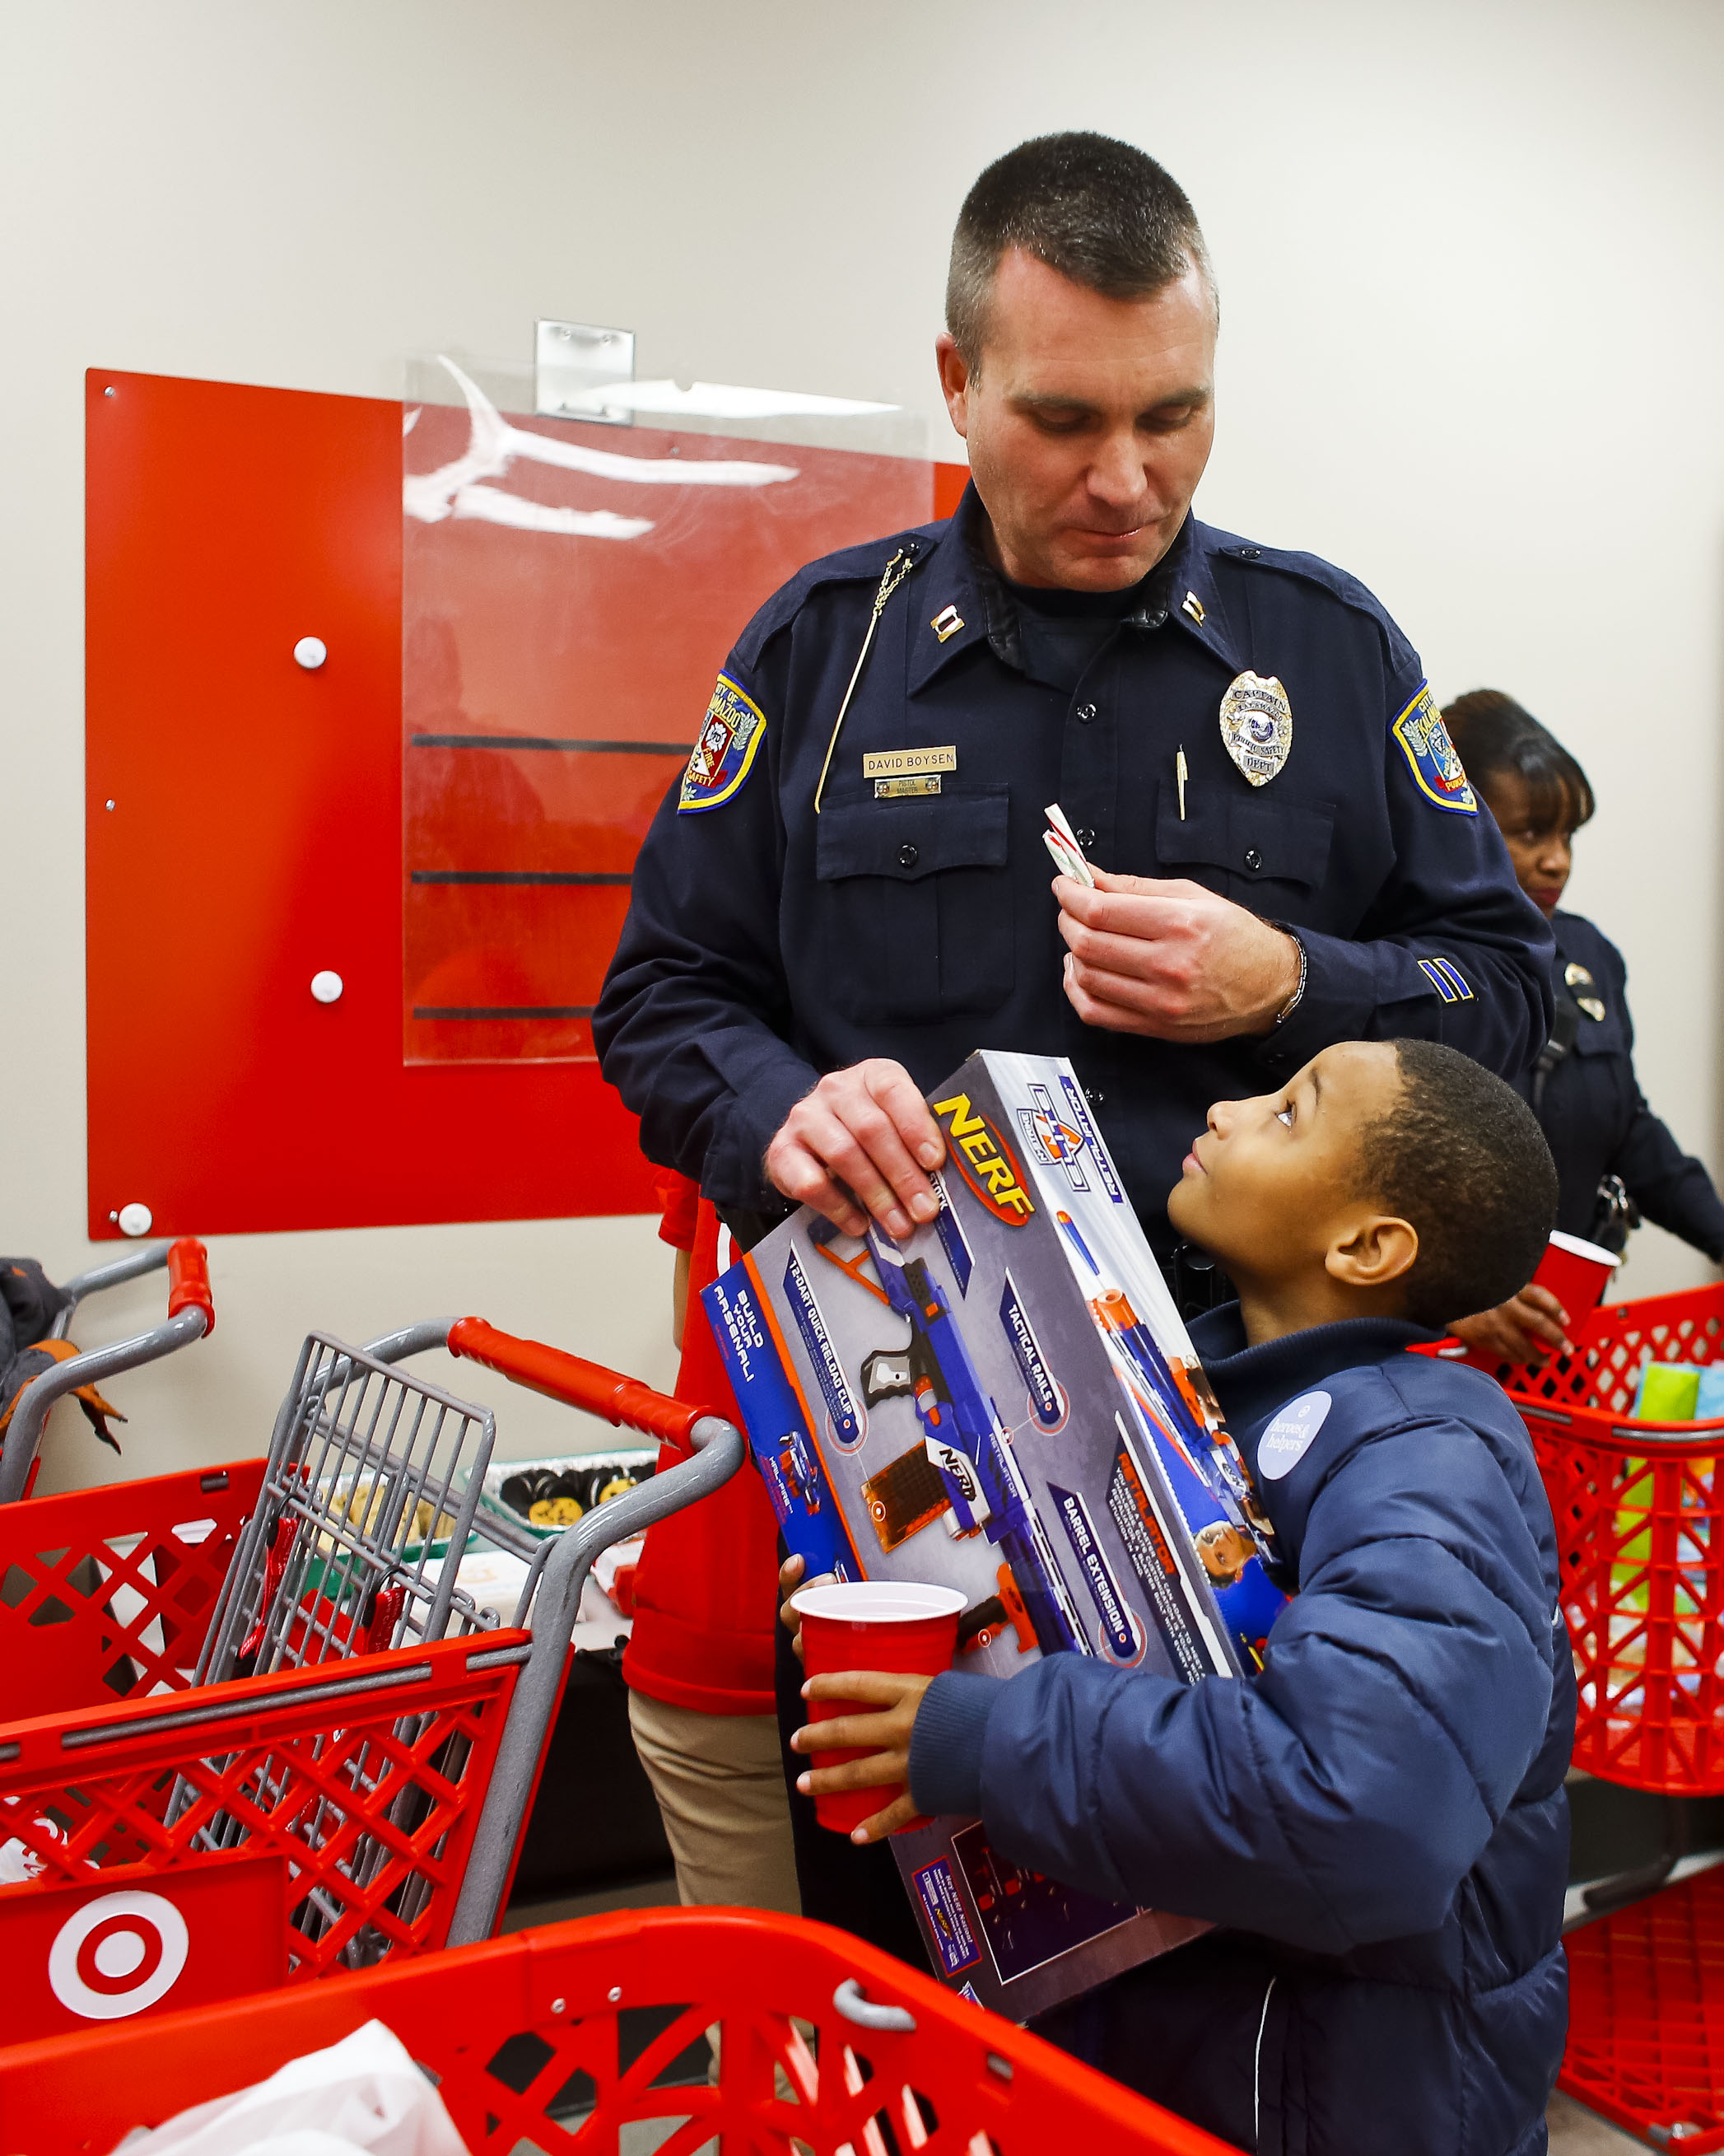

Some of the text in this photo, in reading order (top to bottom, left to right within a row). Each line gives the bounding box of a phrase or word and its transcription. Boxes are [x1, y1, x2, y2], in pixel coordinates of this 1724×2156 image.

[727, 691, 739, 704] OF
[1234, 690, 1286, 712] CAPTAIN
[702, 747, 715, 768] FIRE
[869, 754, 953, 771] DAVID BOYSEN
[1246, 758, 1271, 772] DEPT
[1260, 745, 1284, 755] SAFETY
[933, 1092, 1035, 1215] NERF
[1035, 1089, 1084, 1186] ELITE
[1065, 1086, 1119, 1197] RETALIATOR
[734, 1303, 753, 1349] YOUR
[737, 1289, 764, 1348] BUILD
[789, 1259, 813, 1308] 12-DART
[808, 1306, 827, 1343] QUICK
[820, 1342, 841, 1390] RELOAD
[837, 1387, 853, 1416] CLIP
[1009, 1304, 1037, 1365] TACTICAL
[1031, 1363, 1053, 1402] RAILS
[939, 1448, 976, 1498] NERF
[989, 1433, 1018, 1498] RETALIATOR
[1265, 1433, 1303, 1454] helpers
[1109, 1499, 1129, 1541] SITUATION
[1127, 1542, 1133, 1552] IN
[1063, 1496, 1093, 1555] BARREL
[1086, 1553, 1125, 1633] EXTENSION
[1116, 1467, 1125, 1486] YOU
[1124, 1487, 1136, 1510] NEED
[1138, 1521, 1156, 1558] BLASTER
[1154, 1559, 1166, 1581] THAT
[1163, 1582, 1173, 1601] CAN
[1172, 1603, 1186, 1629] ADAPT
[1184, 1631, 1192, 1644] TO
[1190, 1645, 1203, 1669] MEET
[1135, 1529, 1148, 1553] ELITE
[1146, 1555, 1175, 1620] CUSTOMIZATION
[1173, 1622, 1179, 1631] IS
[1178, 1631, 1192, 1662] YOURS
[1138, 1553, 1156, 1590] BLASTER
[1153, 1590, 1167, 1615] BUILT
[1164, 1617, 1176, 1639] WITH
[1173, 1640, 1189, 1668] EVERY
